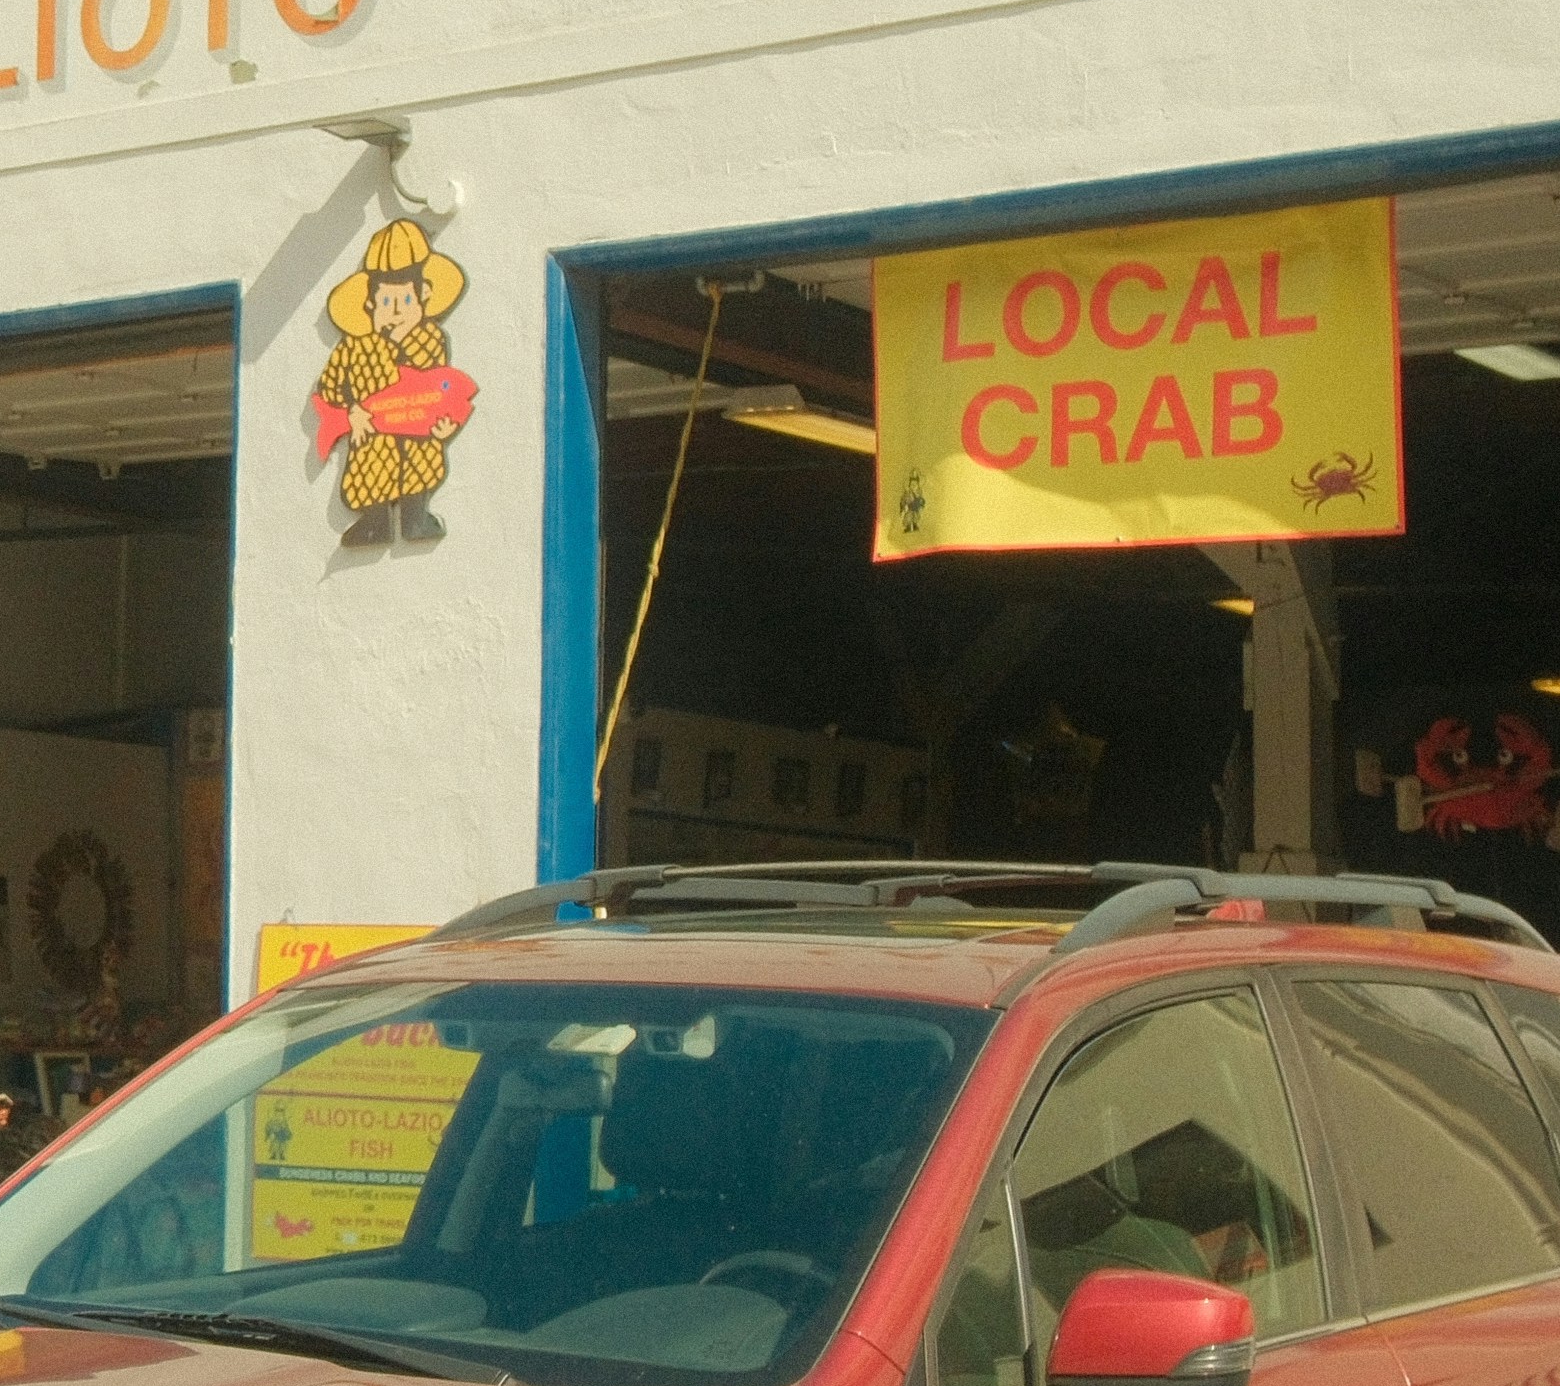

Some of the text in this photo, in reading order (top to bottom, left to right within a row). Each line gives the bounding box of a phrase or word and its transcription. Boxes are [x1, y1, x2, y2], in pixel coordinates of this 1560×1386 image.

[941, 250, 1317, 363] LOCAL
[960, 368, 1284, 470] CRAB
[304, 1109, 443, 1131] ALIOTO-LAZIO
[350, 1140, 393, 1158] FISH
